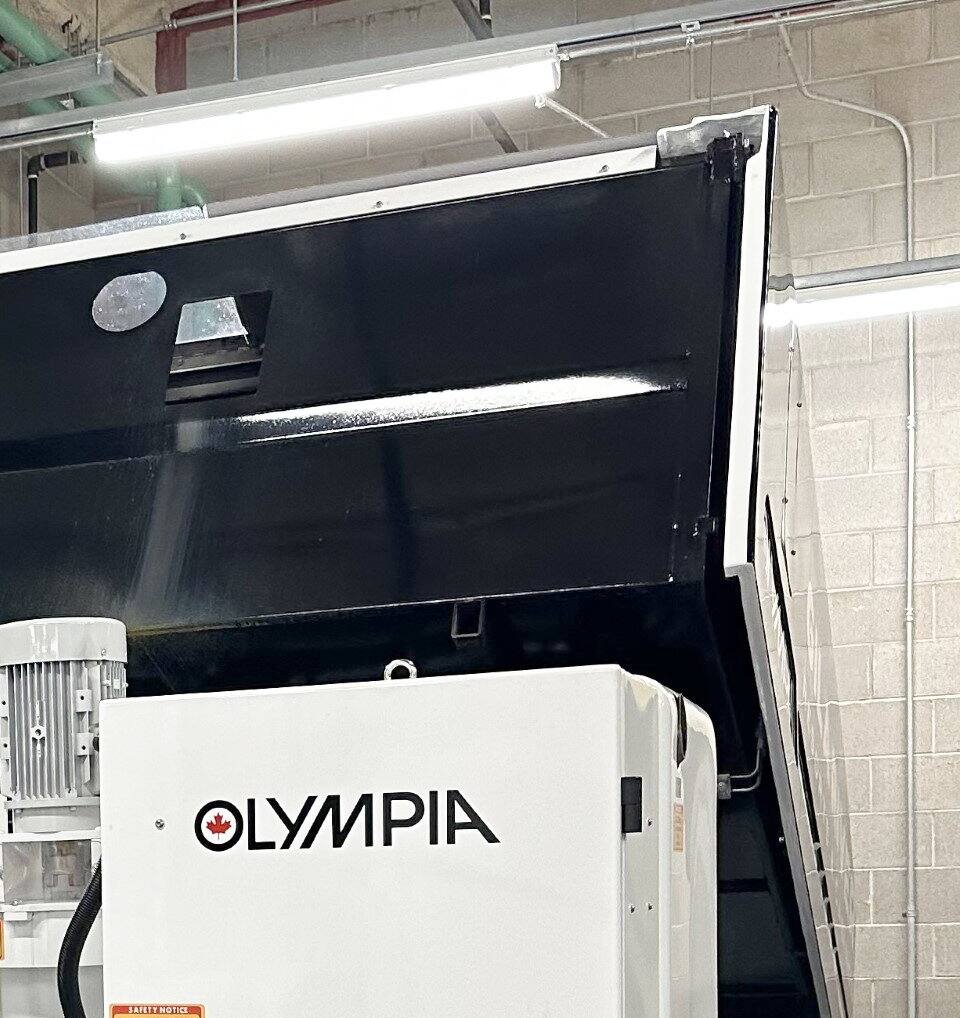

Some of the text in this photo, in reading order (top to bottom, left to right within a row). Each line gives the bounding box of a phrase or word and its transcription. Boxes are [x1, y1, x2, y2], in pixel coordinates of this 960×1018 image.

[194, 790, 501, 851] OLYMPIA
[128, 1006, 189, 1014] SAFETY NOTICE
